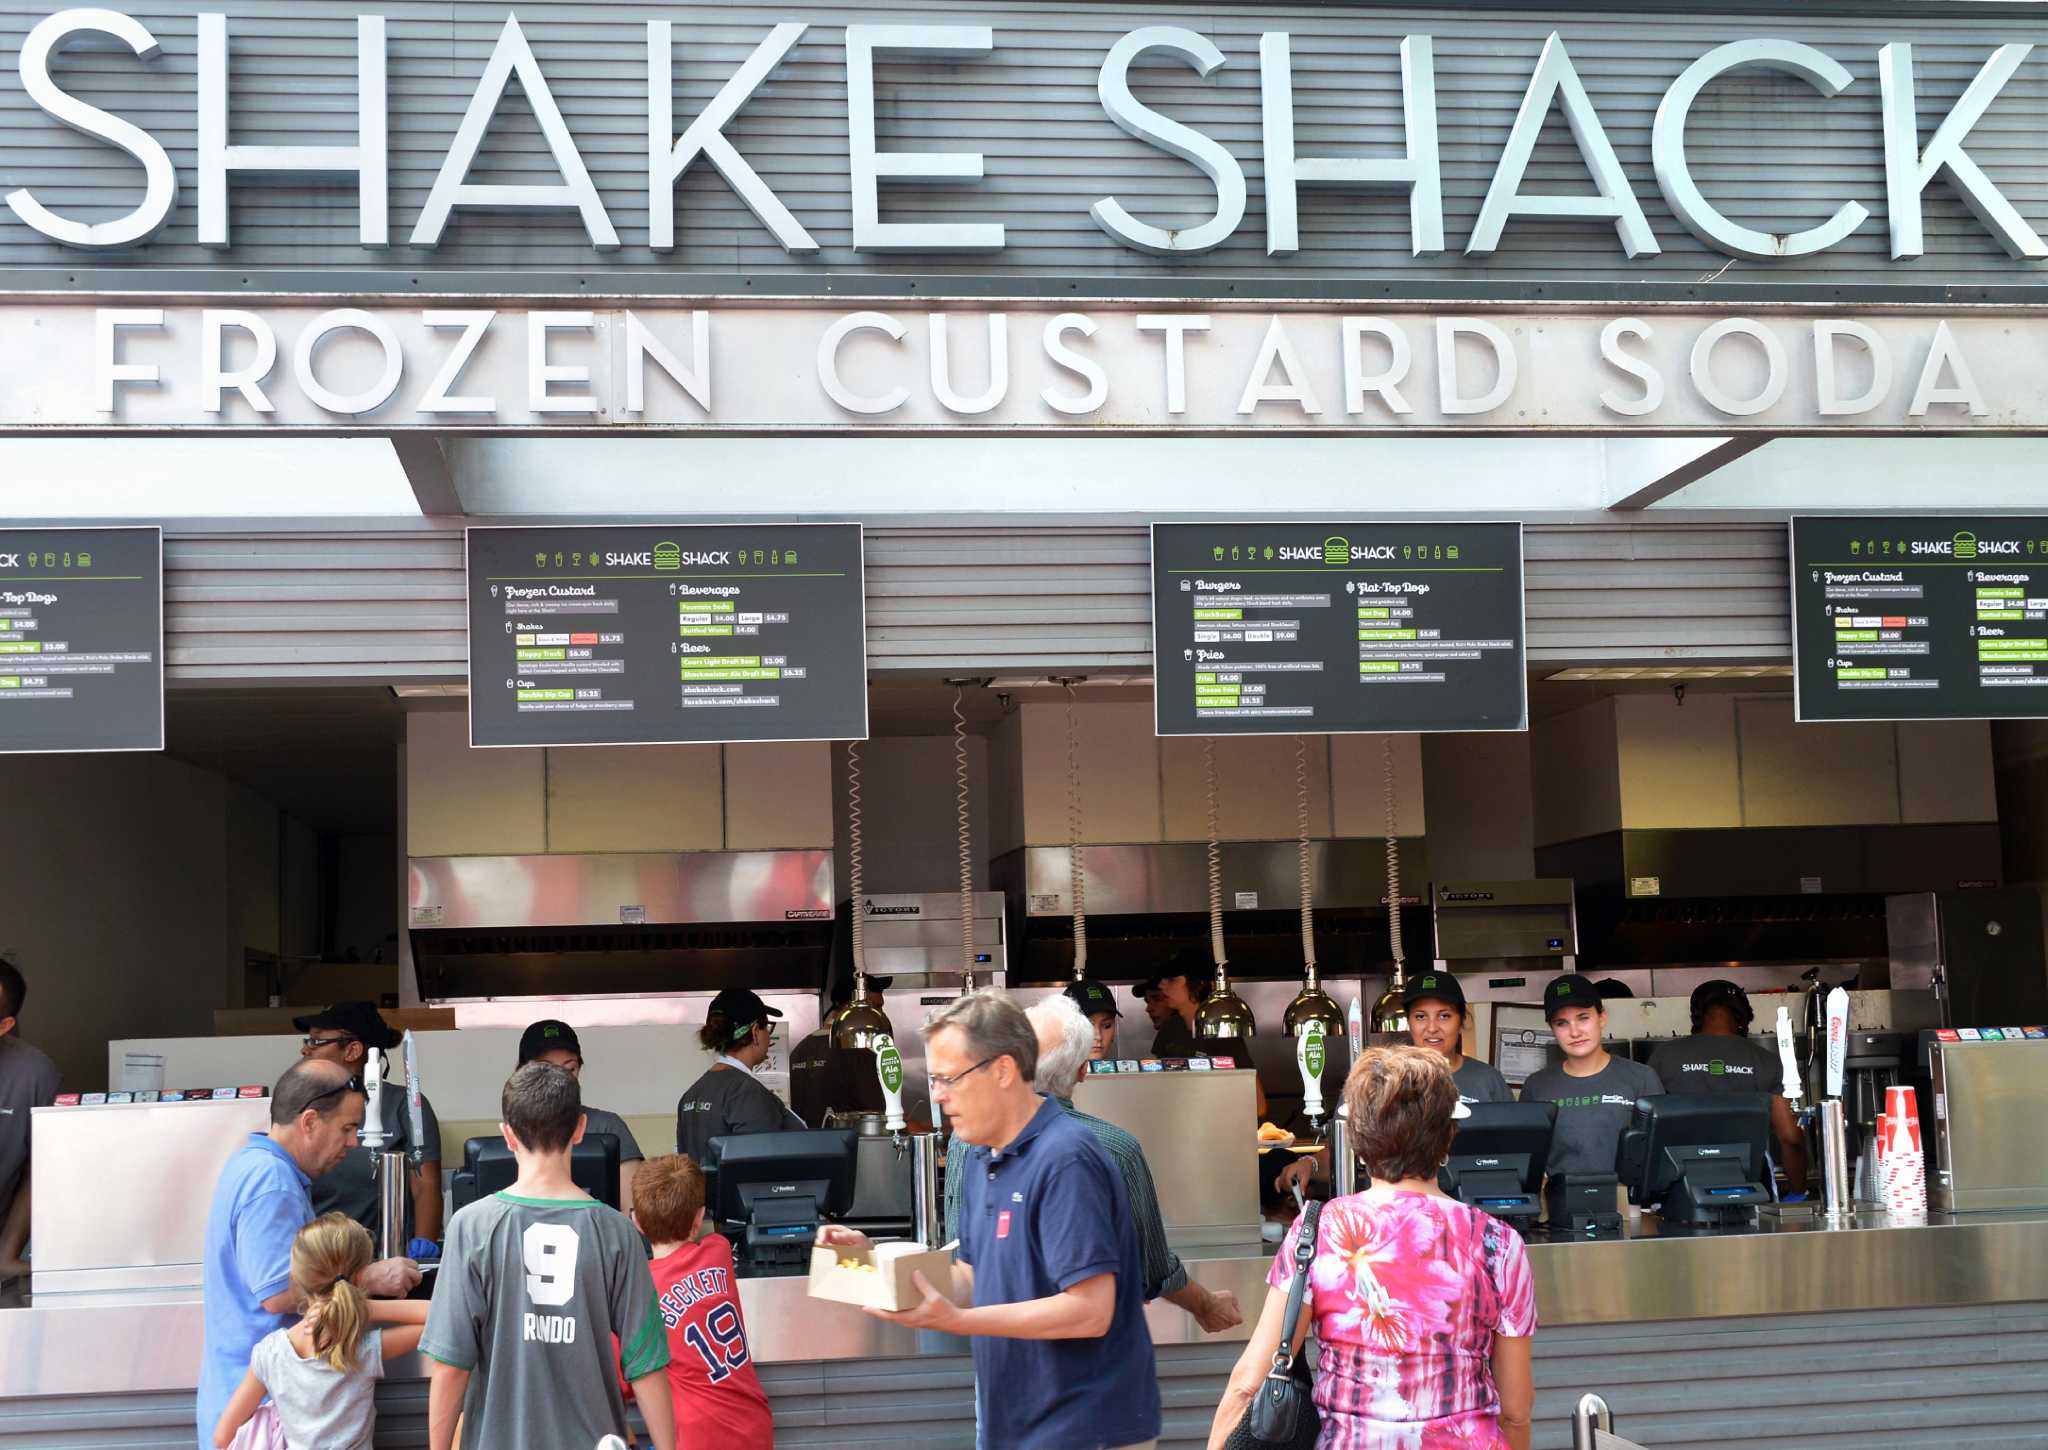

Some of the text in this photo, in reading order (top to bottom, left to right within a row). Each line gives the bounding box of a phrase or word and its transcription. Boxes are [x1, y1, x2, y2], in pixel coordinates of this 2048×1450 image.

[4, 8, 2048, 262] SHAKE SHACK
[94, 307, 1989, 418] FROZEN CUSTARD SODA
[1279, 546, 1396, 560] SHAKE SHACK
[1911, 541, 2020, 554] SHAKE SHACK
[605, 551, 730, 567] SHAKE SHACK
[1824, 571, 1904, 584] Frozen Custard
[1975, 571, 2030, 584] Beverages
[504, 585, 596, 599] Frozen Custard
[679, 584, 741, 597] Beverages
[1195, 579, 1241, 592] Burgers
[1357, 581, 1430, 596] Flat-Top Dogs
[25, 591, 58, 605] Dogs
[516, 622, 544, 631] Shakes
[1977, 626, 2006, 636] Beer
[680, 642, 711, 653] Beer
[1196, 649, 1225, 662] Fries
[1836, 659, 1853, 668] Cups
[517, 680, 536, 689] Cups
[864, 904, 918, 915] VICTORY
[1308, 1051, 1321, 1059] Ale
[885, 1065, 899, 1074] Ale
[1682, 1063, 1754, 1074] SHAKE SHACK
[523, 1222, 580, 1307] 9
[660, 1266, 728, 1329] BECKETT
[684, 1300, 749, 1385] 19
